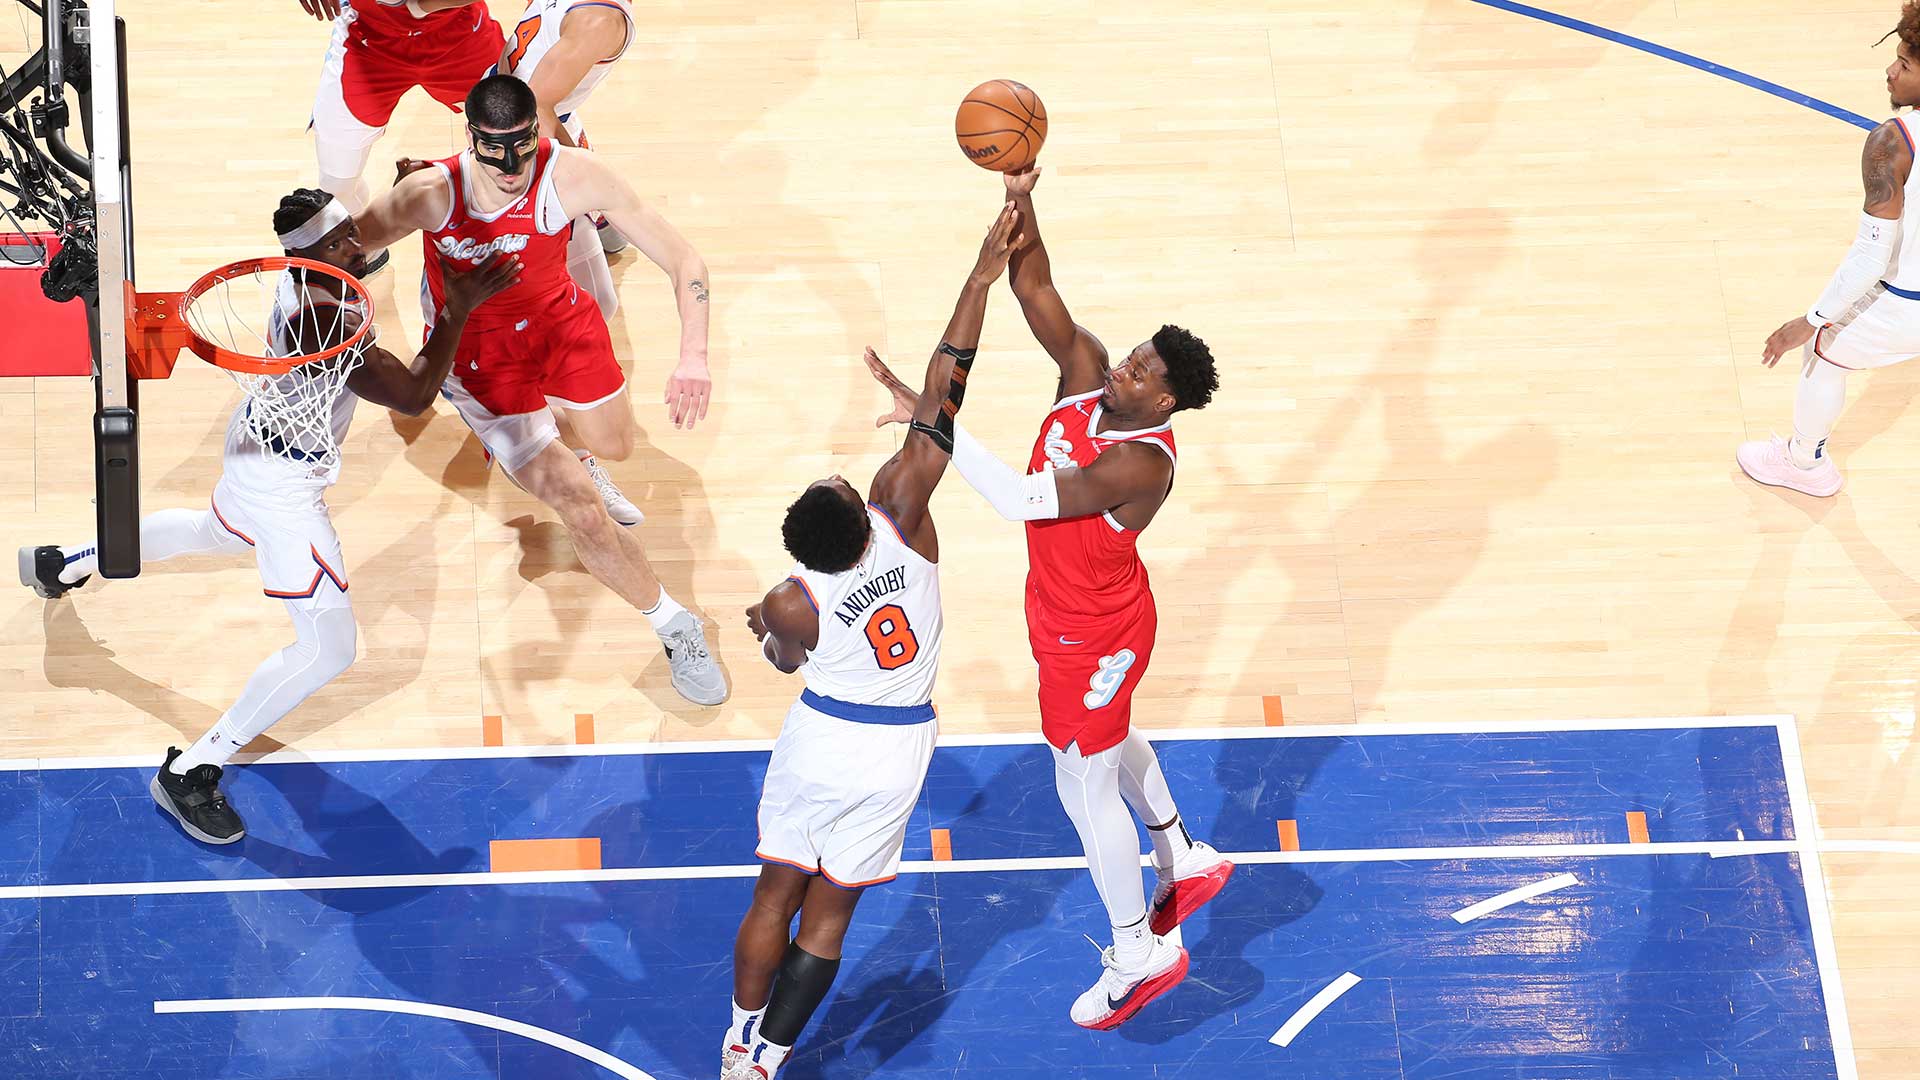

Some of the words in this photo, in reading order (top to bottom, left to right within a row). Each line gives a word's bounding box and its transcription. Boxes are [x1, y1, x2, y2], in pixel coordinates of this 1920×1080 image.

[433, 233, 530, 265] Memphis
[835, 565, 906, 628] ANUNOBY
[864, 603, 920, 671] 8
